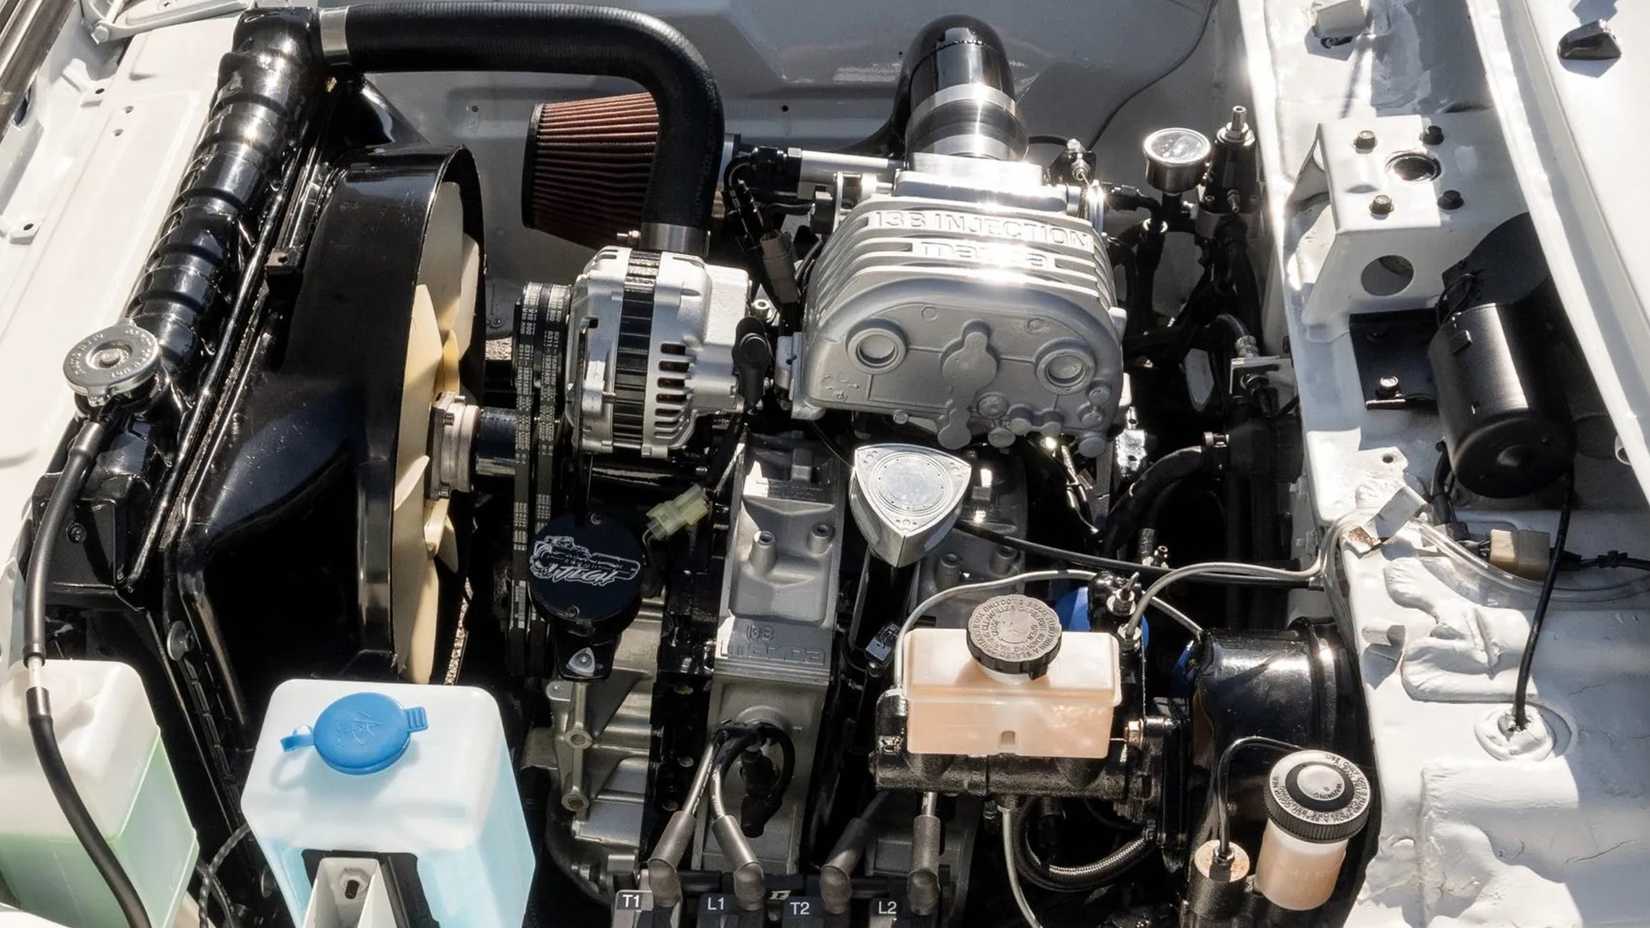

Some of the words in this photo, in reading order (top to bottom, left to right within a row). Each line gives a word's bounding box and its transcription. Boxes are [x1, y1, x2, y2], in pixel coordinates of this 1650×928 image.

[874, 209, 927, 229] 13B
[935, 211, 1089, 248] INJECTION
[918, 240, 1048, 268] maa
[621, 893, 641, 908] T1
[706, 896, 725, 911] L1
[789, 901, 811, 915] T2
[877, 900, 897, 915] L2
